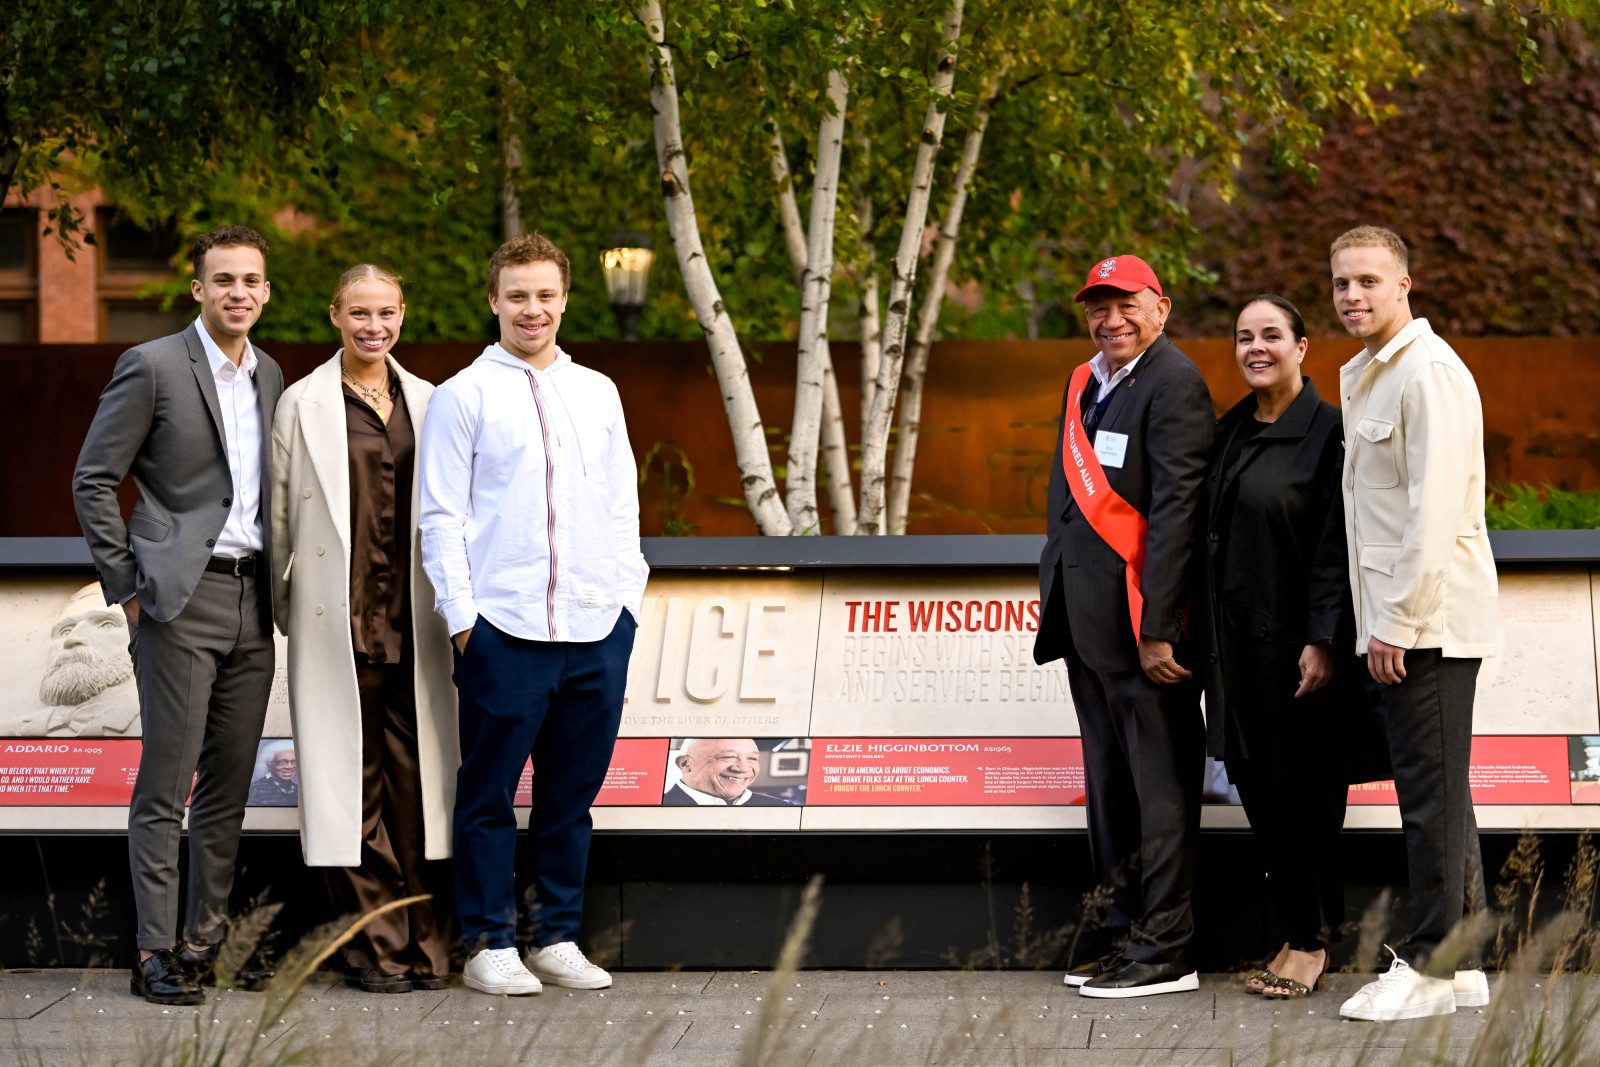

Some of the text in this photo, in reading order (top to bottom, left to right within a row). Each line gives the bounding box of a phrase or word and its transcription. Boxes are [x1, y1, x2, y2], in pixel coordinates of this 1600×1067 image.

[1079, 468, 1096, 497] ALUM
[845, 601, 900, 633] THE
[843, 635, 927, 667] BEGINS
[935, 635, 993, 667] WITH
[839, 670, 1072, 702] AND SERVICE BEGIN
[622, 716, 647, 725] OVE
[651, 716, 673, 725] THE
[677, 716, 710, 725] LIVES
[4, 745, 69, 753] ADDARIO
[826, 744, 863, 752] ELZIE
[868, 744, 979, 752] HIGGINBOTTOM
[8, 767, 33, 775] BELIEVE
[33, 767, 49, 775] THAT
[49, 767, 68, 775] WHEN
[68, 767, 79, 775] IT'S
[80, 767, 96, 775] TIME
[848, 766, 856, 774] IN
[856, 766, 883, 774] AMERICA
[884, 766, 891, 774] IS
[892, 766, 912, 774] ABOUT
[913, 766, 951, 774] ECONOMICS.
[11, 776, 24, 784] AND
[28, 776, 50, 784] WOULD
[51, 776, 76, 784] RATHER
[76, 776, 91, 784] HAVE
[823, 775, 968, 783] SOME BRAVE FOLKS SAT AT THE LUNCH COUNTER.
[7, 785, 25, 793] WHEN
[25, 785, 37, 793] IT'S
[37, 785, 52, 793] THAT
[833, 784, 858, 792] BOUGHT
[859, 784, 870, 792] THE
[871, 784, 891, 792] LUNCH
[1349, 783, 1361, 791] HEY
[1362, 783, 1380, 791] WANT
[1381, 783, 1389, 791] TO
